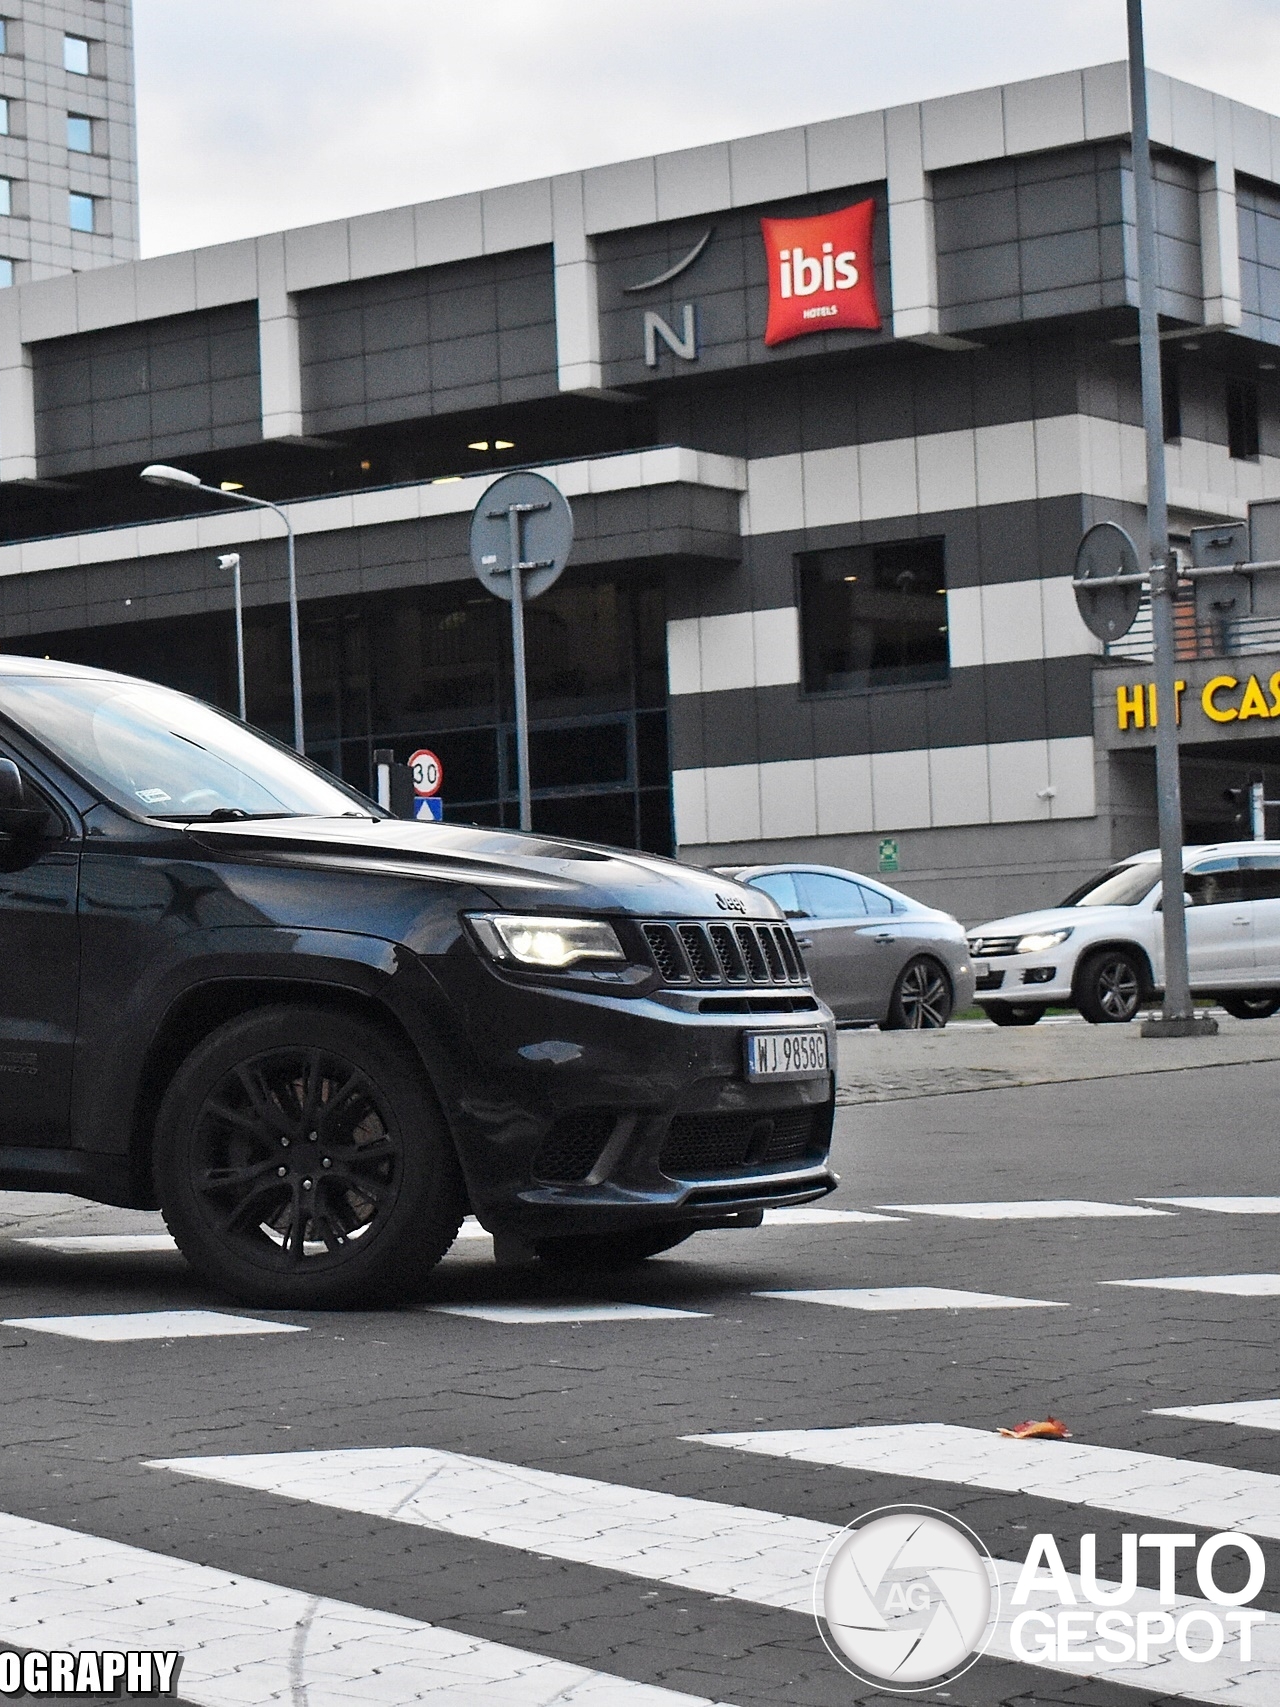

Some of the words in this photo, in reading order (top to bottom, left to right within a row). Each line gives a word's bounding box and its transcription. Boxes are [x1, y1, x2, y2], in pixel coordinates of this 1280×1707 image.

[780, 242, 859, 299] ibis
[803, 304, 838, 319] HOTELS
[644, 304, 696, 366] N
[413, 764, 436, 784] 30
[715, 893, 747, 915] Jeep
[757, 1037, 777, 1072] WJ
[783, 1035, 824, 1070] 9858G
